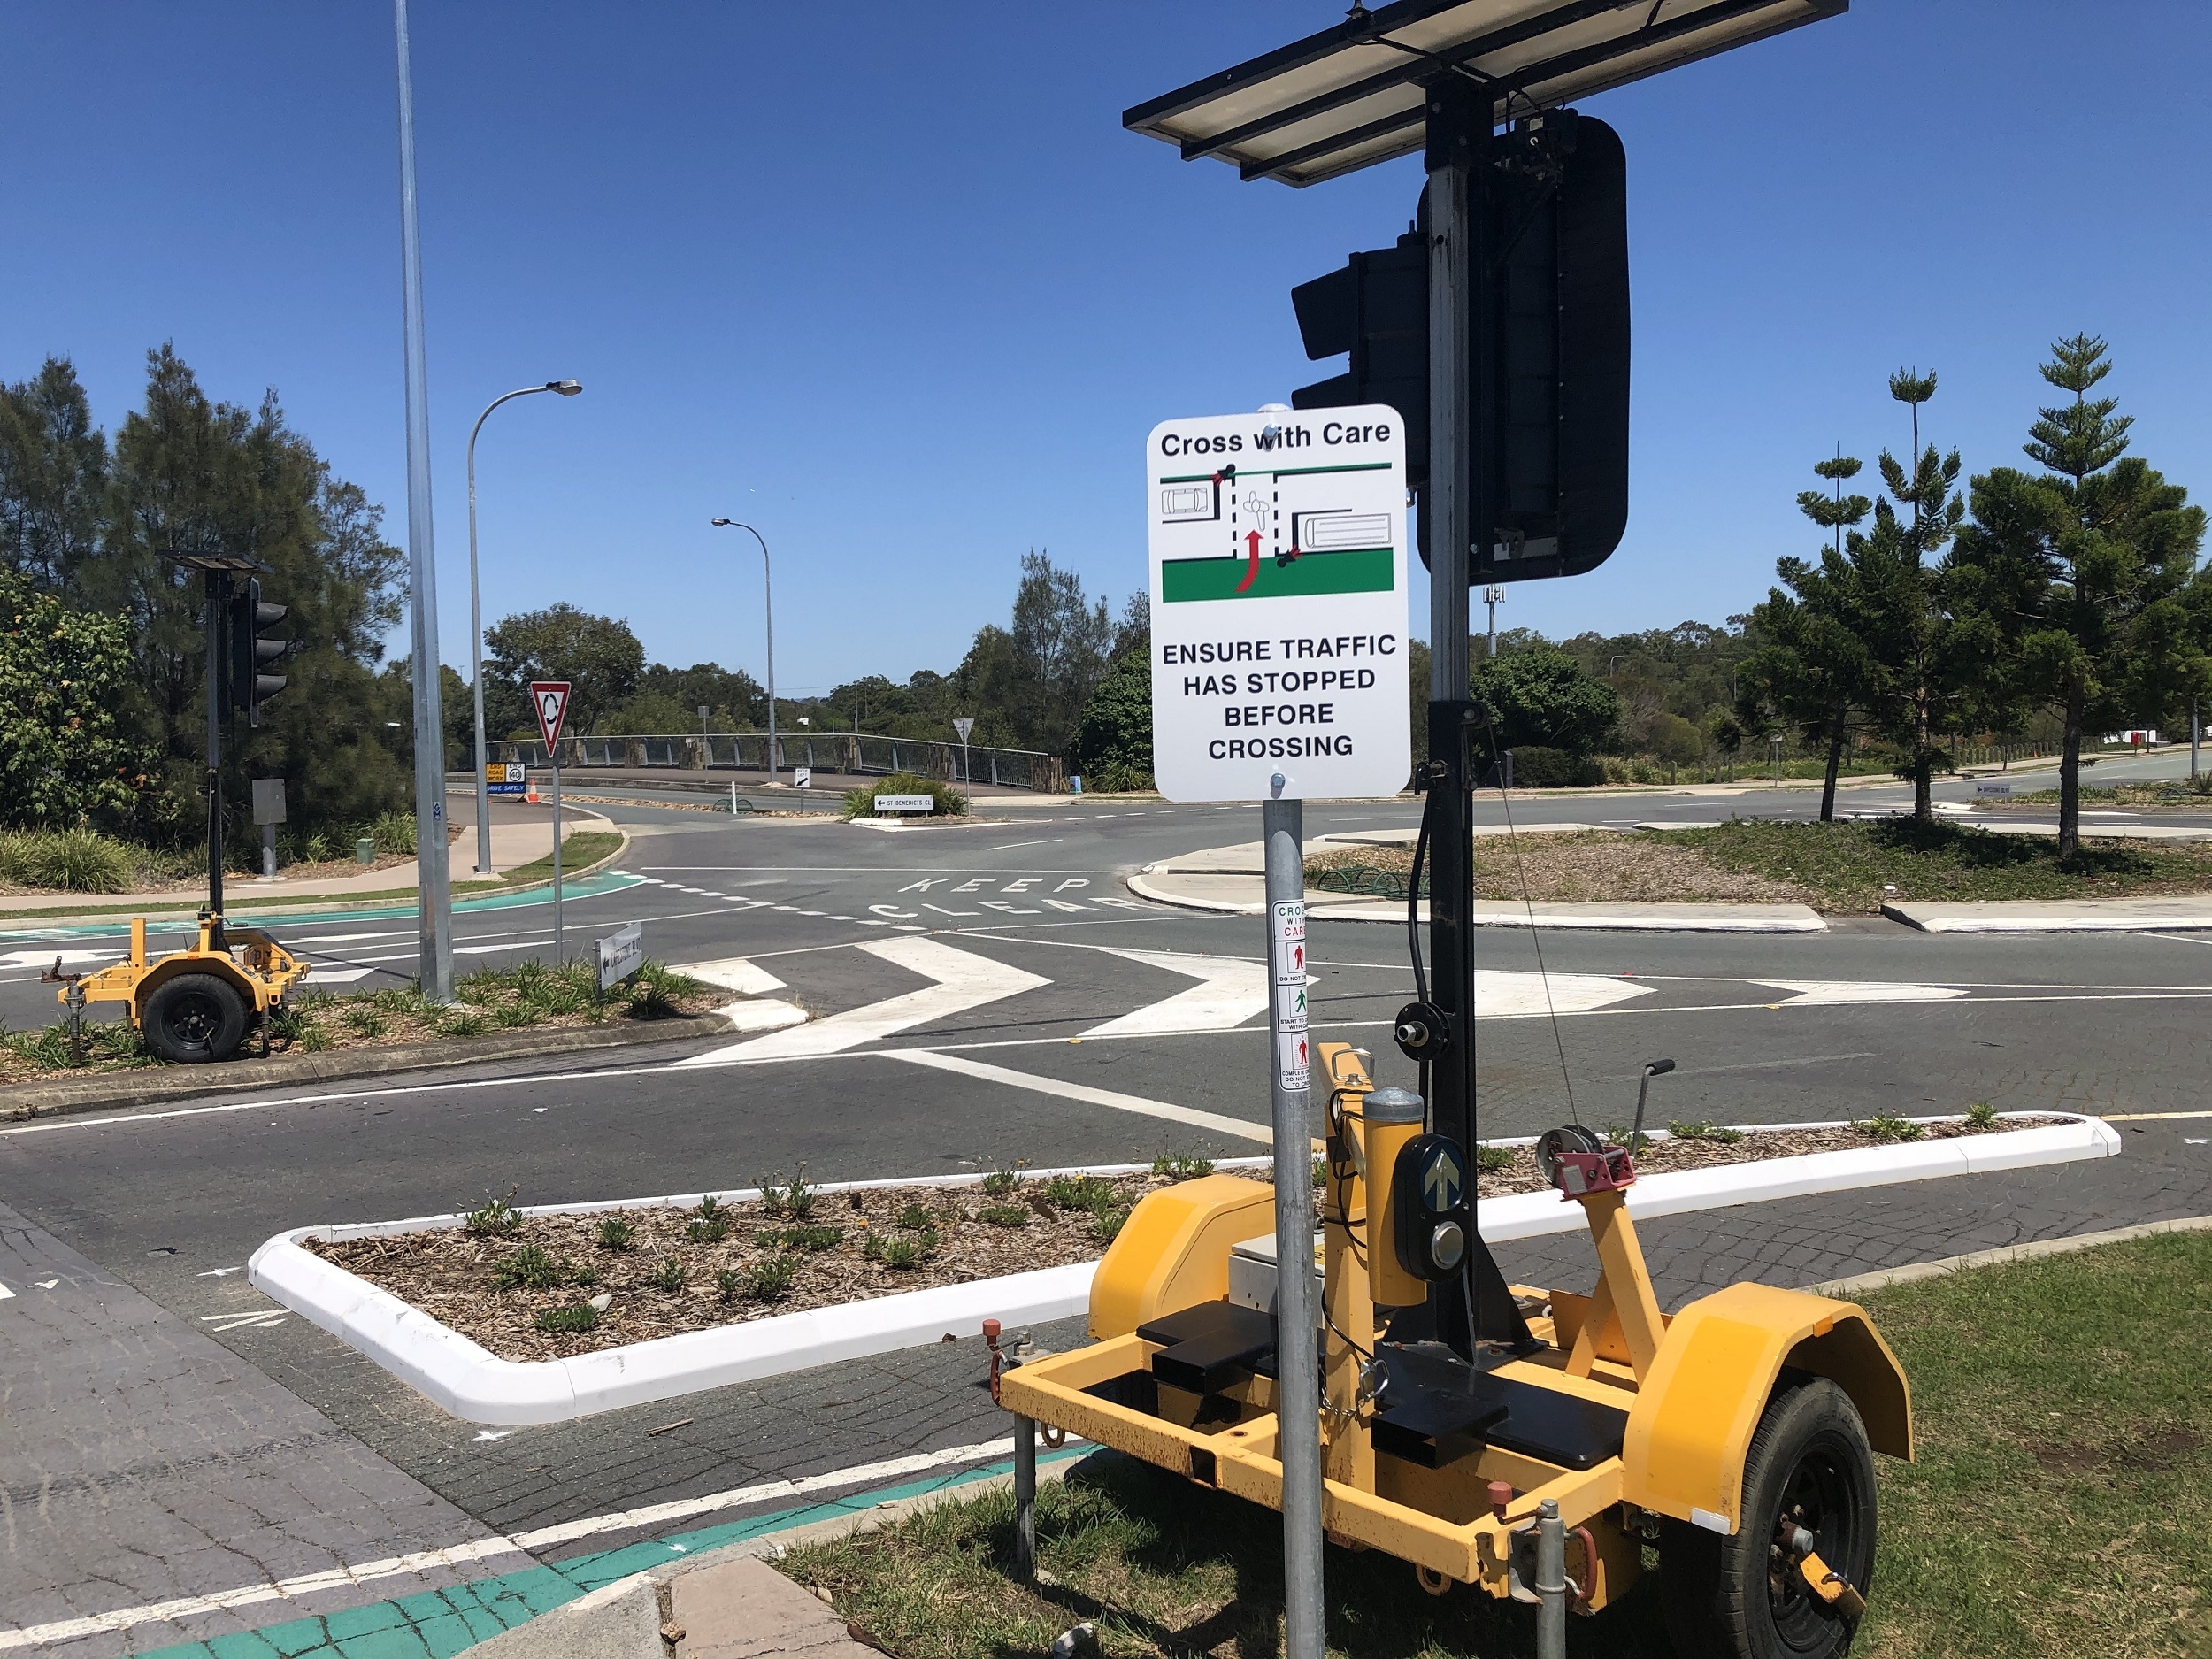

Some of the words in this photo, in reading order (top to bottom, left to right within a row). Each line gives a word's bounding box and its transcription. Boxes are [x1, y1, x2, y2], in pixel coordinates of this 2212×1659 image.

[1161, 434, 1243, 457] Cross
[1253, 425, 1311, 450] with
[1323, 422, 1391, 445] Care
[1163, 641, 1271, 664] ENSURE
[1280, 634, 1396, 659] TRAFFIC
[1184, 674, 1237, 695] HAS
[1247, 669, 1376, 694] STOPPED
[1225, 703, 1334, 726] BEFORE
[1209, 735, 1353, 759] CROSSING
[897, 879, 1091, 893] KEEP
[868, 897, 1167, 918] CLEAR
[1279, 905, 1304, 917] CROS
